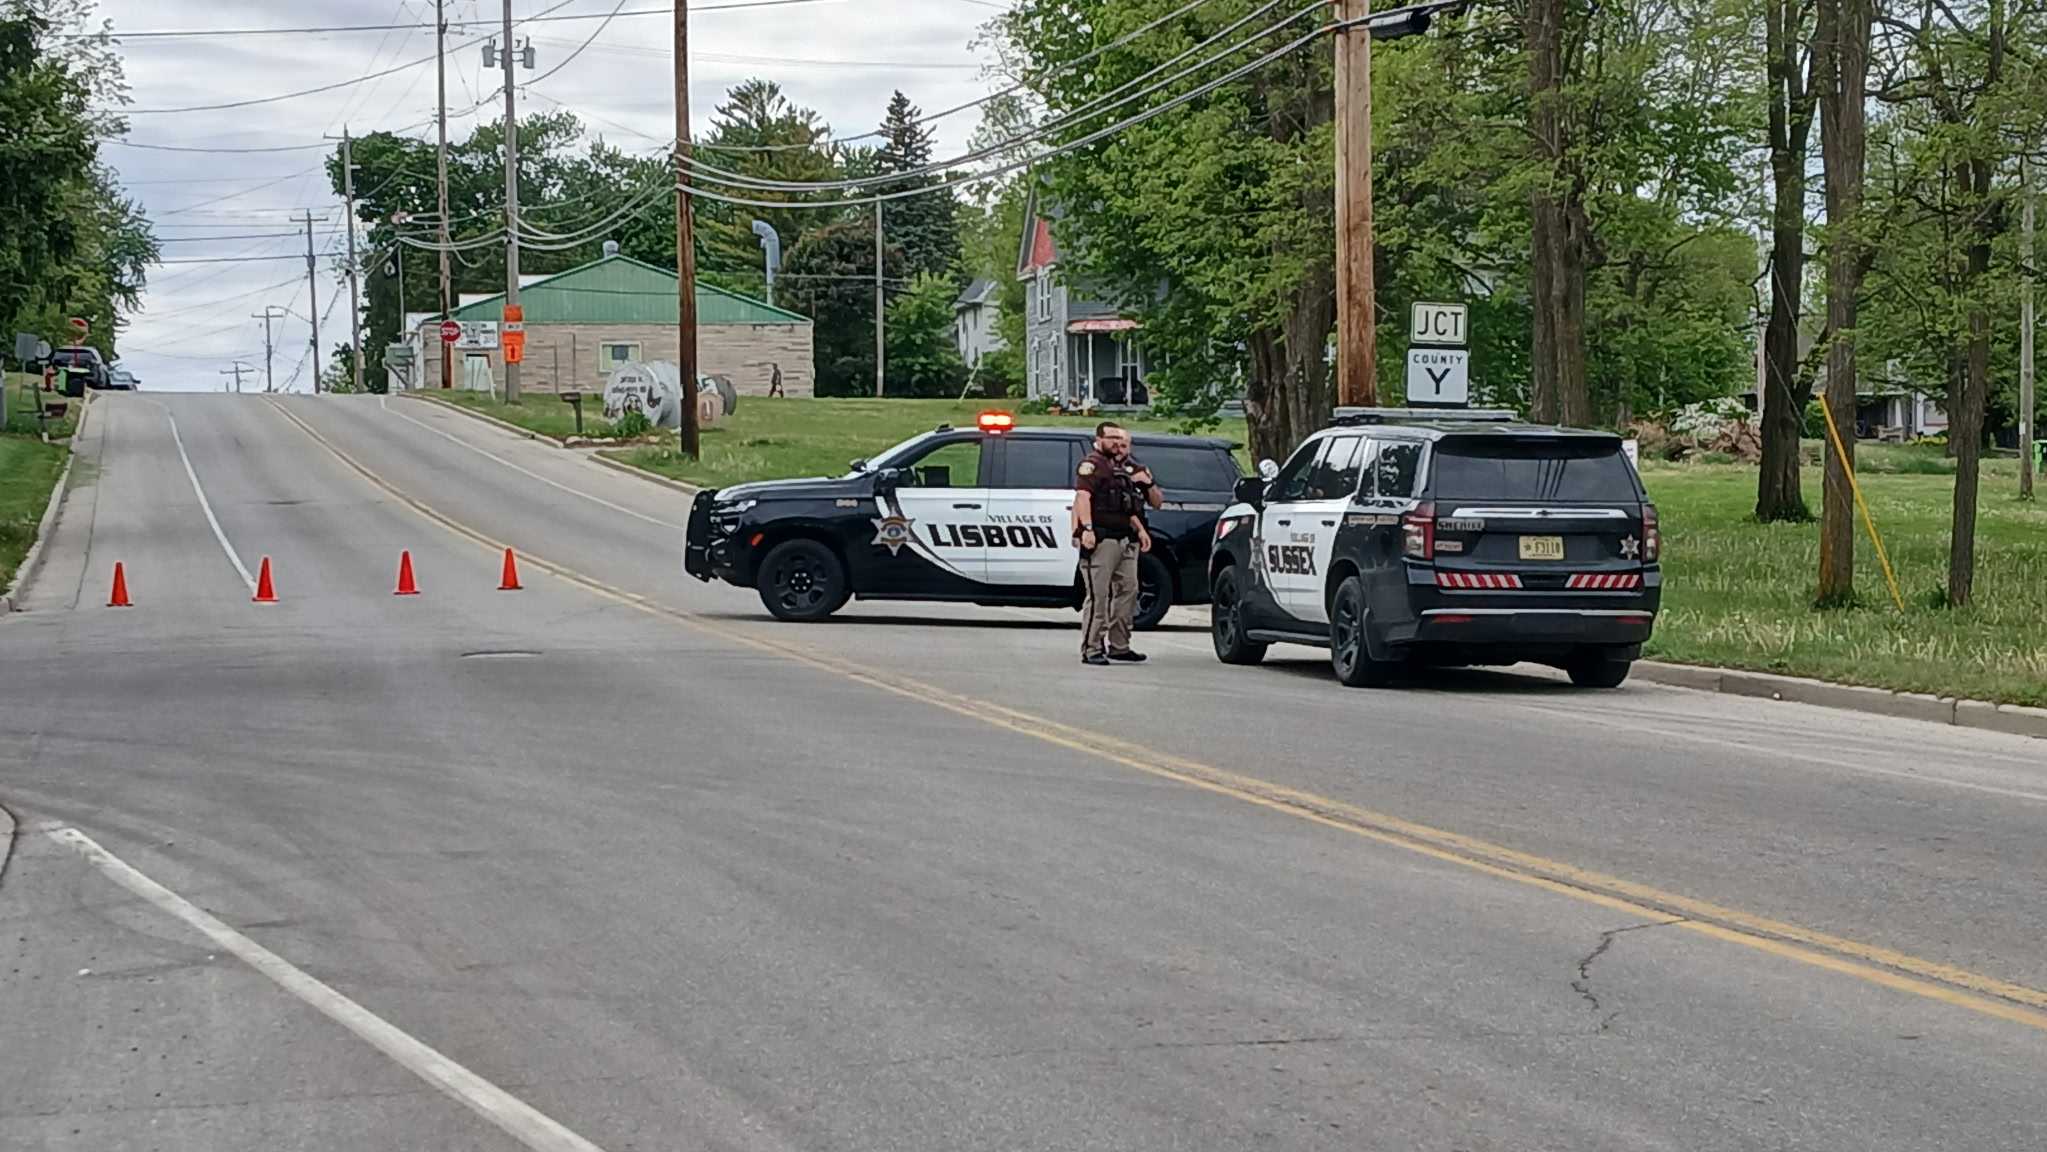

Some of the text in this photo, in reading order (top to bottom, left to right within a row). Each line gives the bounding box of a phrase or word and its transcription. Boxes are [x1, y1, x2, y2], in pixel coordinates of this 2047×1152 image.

[1417, 311, 1462, 336] JCT
[1413, 354, 1463, 365] COUNTY
[1425, 368, 1451, 395] Y
[987, 515, 1036, 523] VILLAGE
[926, 523, 1058, 548] LISBON
[1268, 545, 1317, 576] SUSSEX
